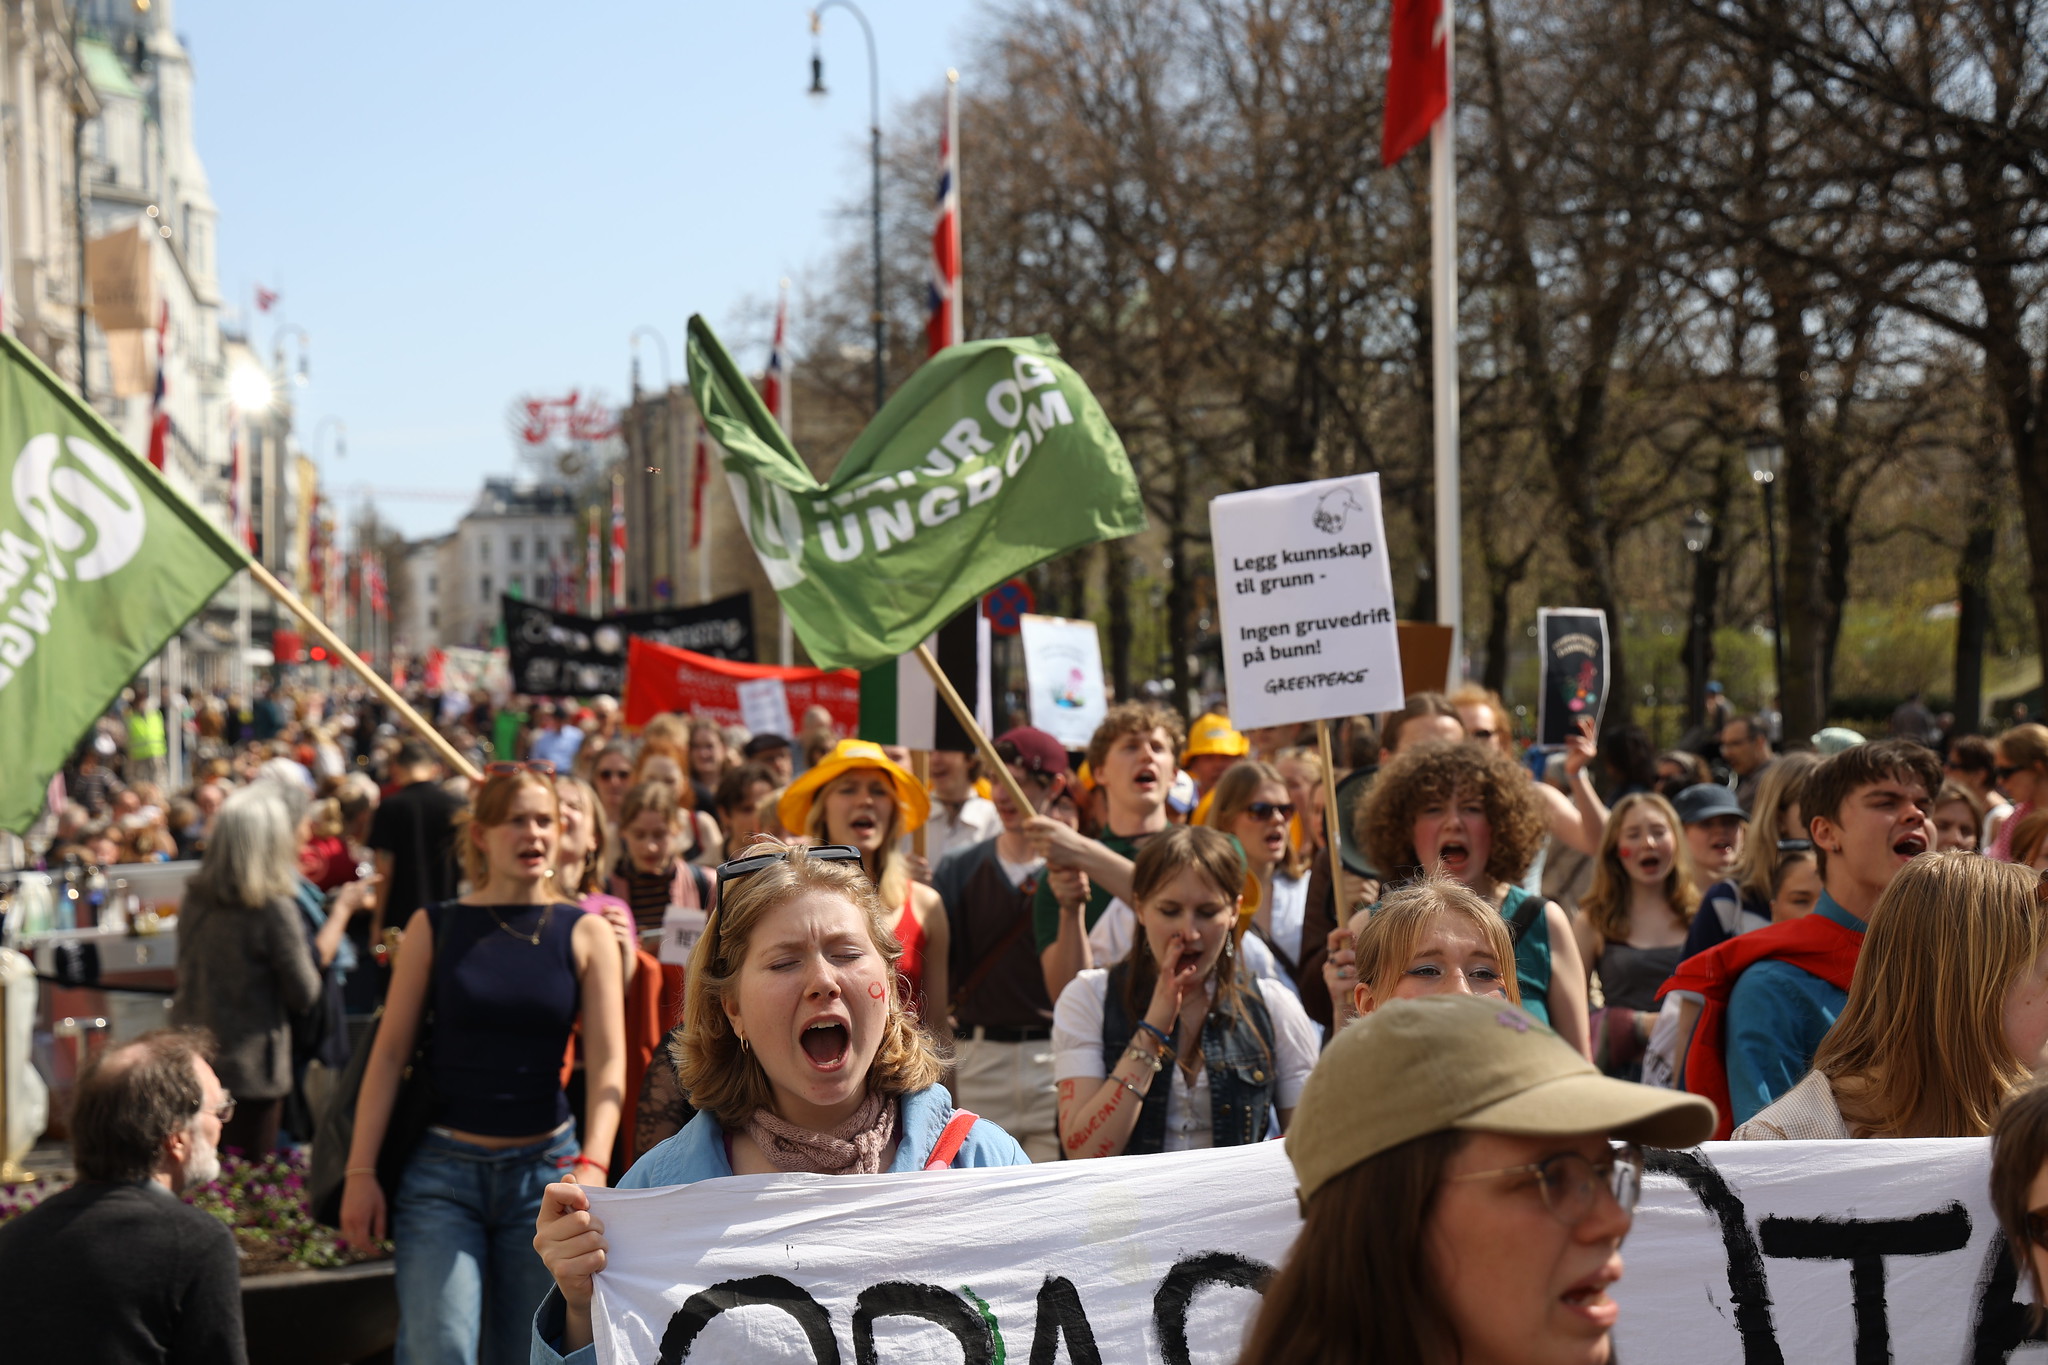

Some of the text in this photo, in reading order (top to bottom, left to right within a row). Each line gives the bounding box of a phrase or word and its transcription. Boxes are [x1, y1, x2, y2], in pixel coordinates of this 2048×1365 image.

[985, 354, 1057, 429] OG
[817, 390, 1074, 563] UNGDOM
[1233, 542, 1373, 572] Legg kunnskap
[1236, 578, 1255, 594] til
[1260, 572, 1314, 595] grunn
[1240, 607, 1391, 642] Ingen gruvedrift
[1243, 639, 1322, 668] på bunn!
[1264, 669, 1369, 694] GREENPEACE
